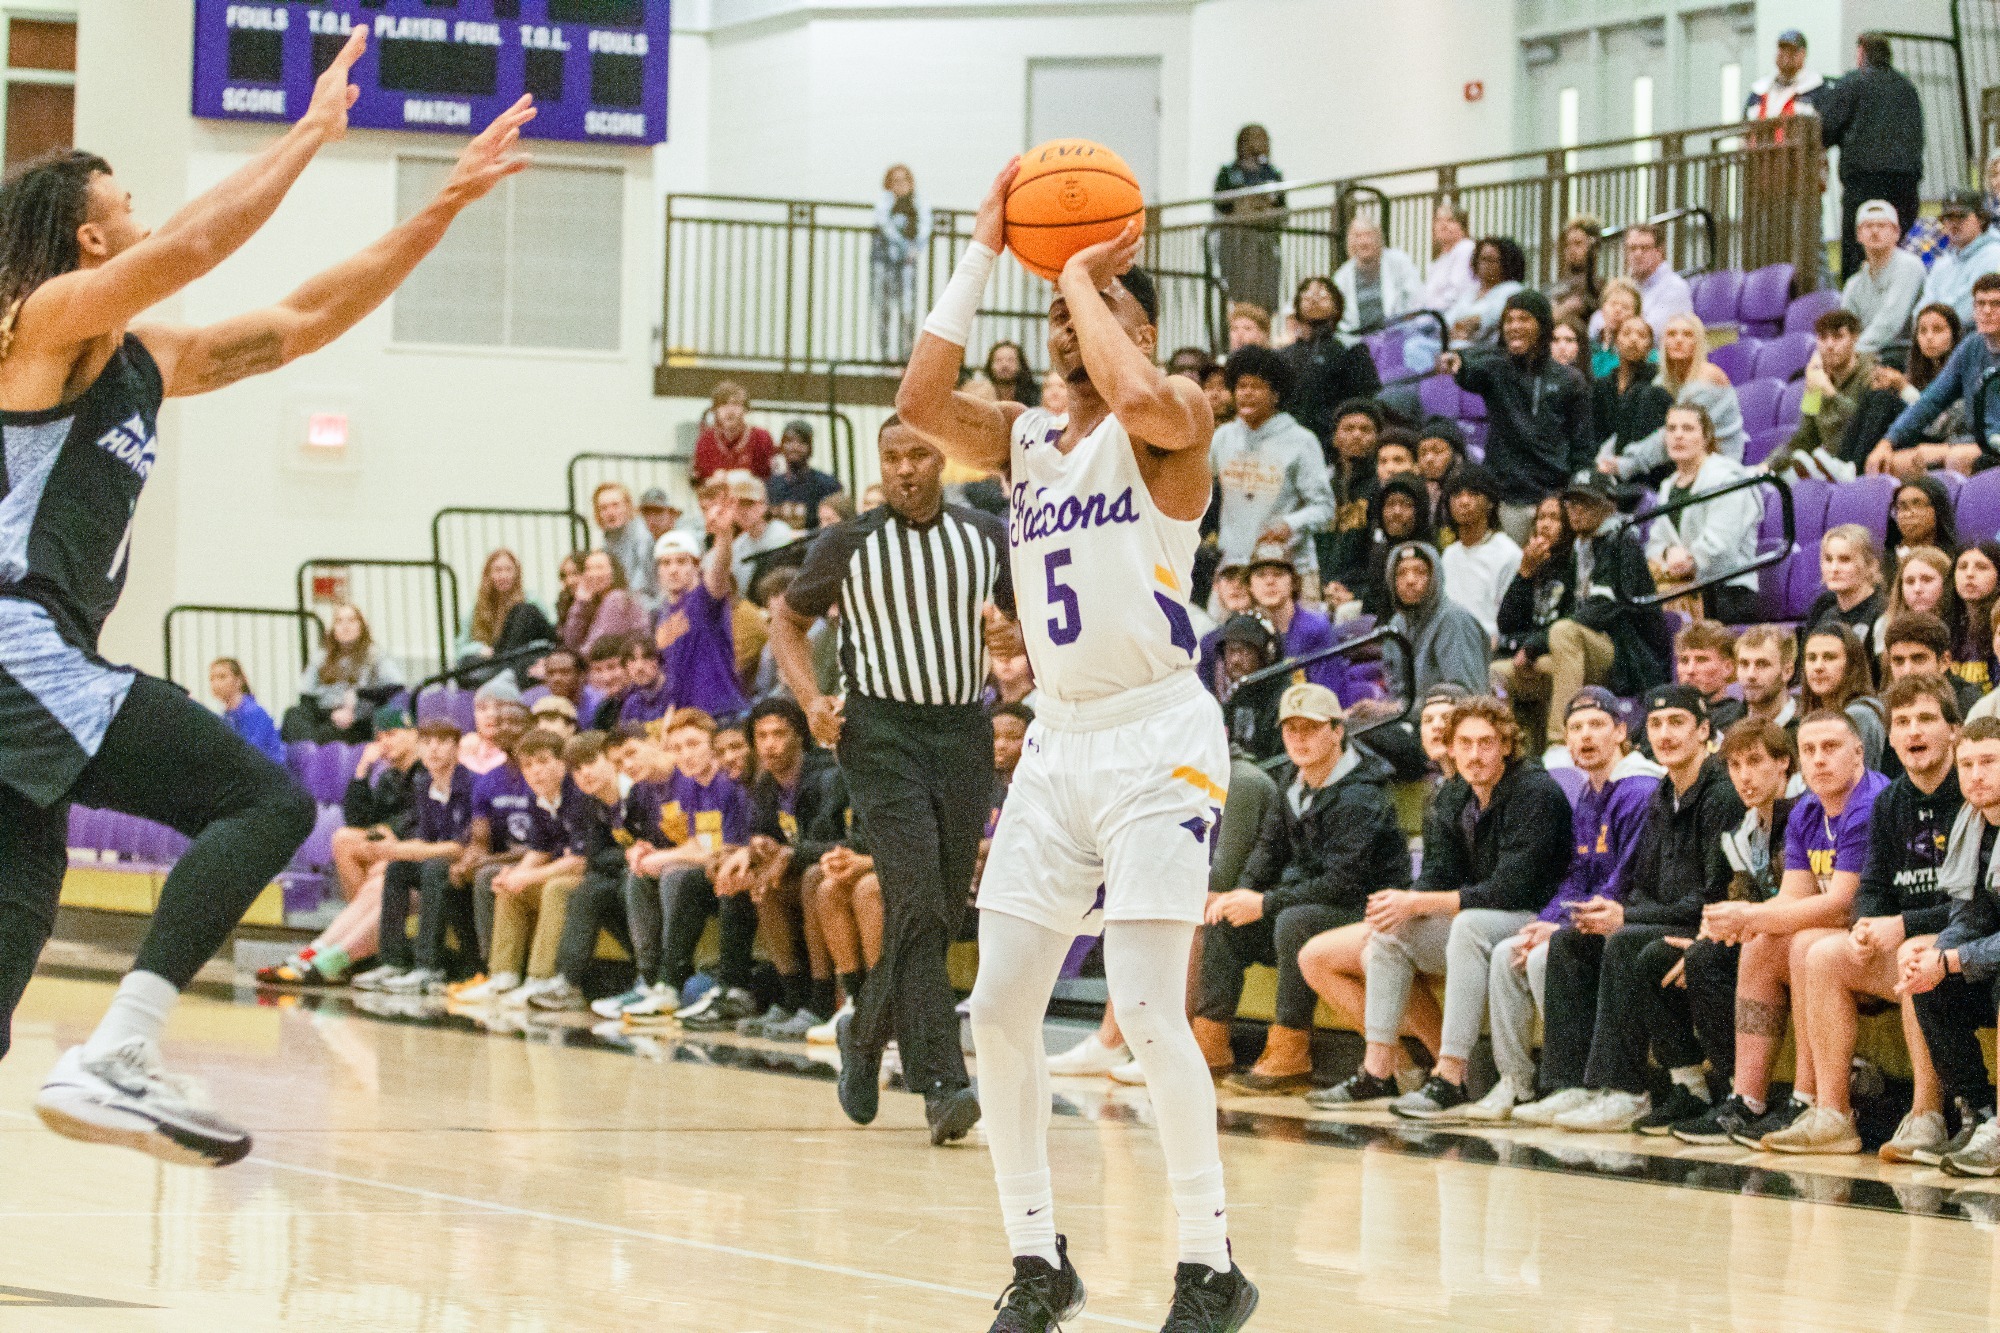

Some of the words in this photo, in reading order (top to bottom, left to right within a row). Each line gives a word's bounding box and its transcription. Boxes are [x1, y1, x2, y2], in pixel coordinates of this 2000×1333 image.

[226, 4, 289, 31] FOULS
[307, 9, 353, 36] T.O.L
[374, 14, 447, 41] PLAYER
[455, 20, 503, 46] FOUL
[588, 29, 649, 56] FOULS
[222, 87, 286, 114] SCORE
[404, 99, 471, 125] MATCH
[585, 111, 647, 137] SCORE
[1044, 548, 1082, 646] 5
